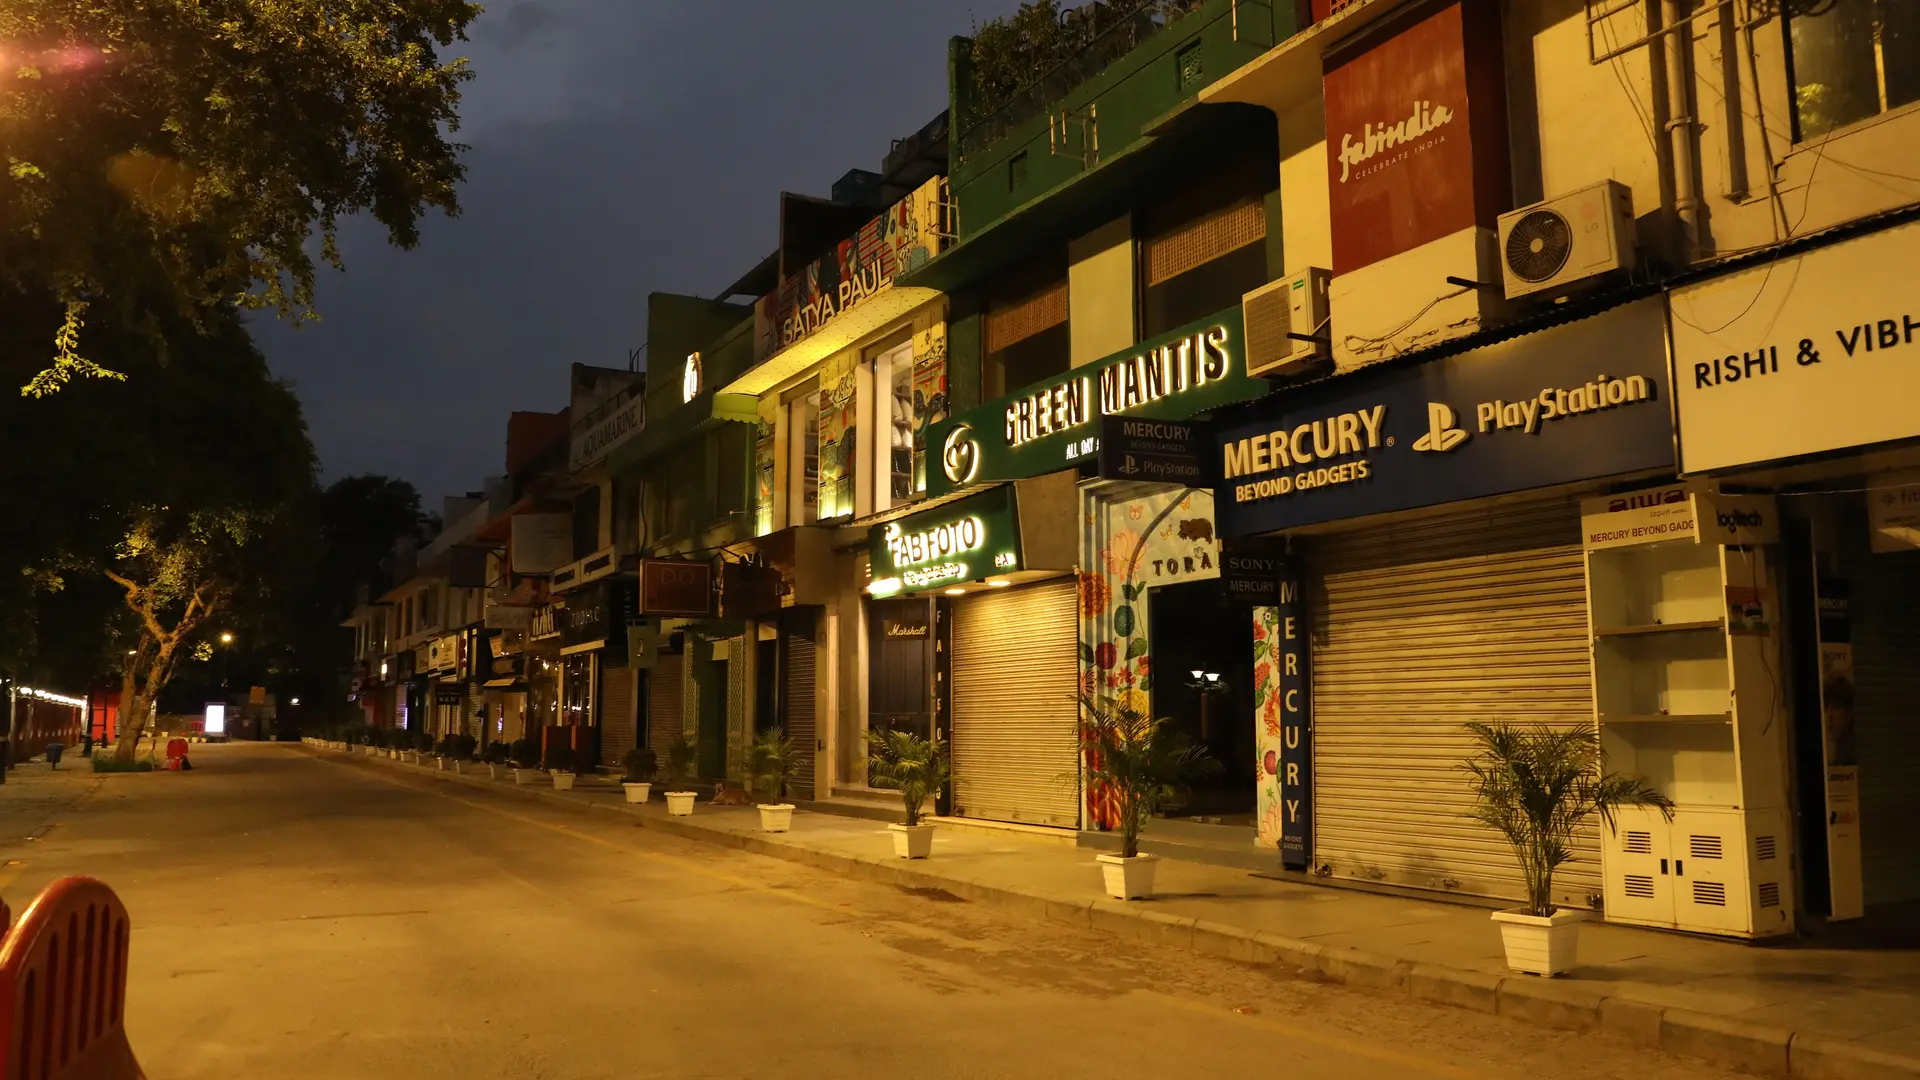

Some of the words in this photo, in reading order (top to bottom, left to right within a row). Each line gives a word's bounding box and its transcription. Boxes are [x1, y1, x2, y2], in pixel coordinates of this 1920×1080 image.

[1338, 100, 1455, 184] fabindia
[1355, 150, 1409, 180] CELEBRATE
[1414, 135, 1446, 155] INDIA
[783, 293, 837, 346] SATYA
[839, 259, 892, 312] PAUL
[1694, 346, 1778, 390] RISHI
[1796, 338, 1821, 366] &
[1004, 377, 1089, 448] GREEN
[1100, 326, 1228, 416] MANTIS
[1476, 373, 1650, 434] PlayStation
[583, 405, 637, 460] AQUAMARINE
[1065, 442, 1079, 460] ALL
[1081, 437, 1094, 455] DAY
[1123, 422, 1191, 441] MERCURY
[1223, 404, 1385, 480] MERCURY
[1143, 461, 1200, 477] PlayStation
[1235, 475, 1292, 503] BEYOND
[1295, 459, 1370, 491] GADGETS
[1590, 528, 1630, 543] MERCURY
[1631, 524, 1668, 538] BEYOND
[1228, 557, 1275, 571] SONY
[1229, 580, 1275, 593] MERCURY
[571, 606, 600, 628] ZODIAC
[887, 624, 927, 636] Marshall
[1280, 580, 1300, 824] MERCURY
